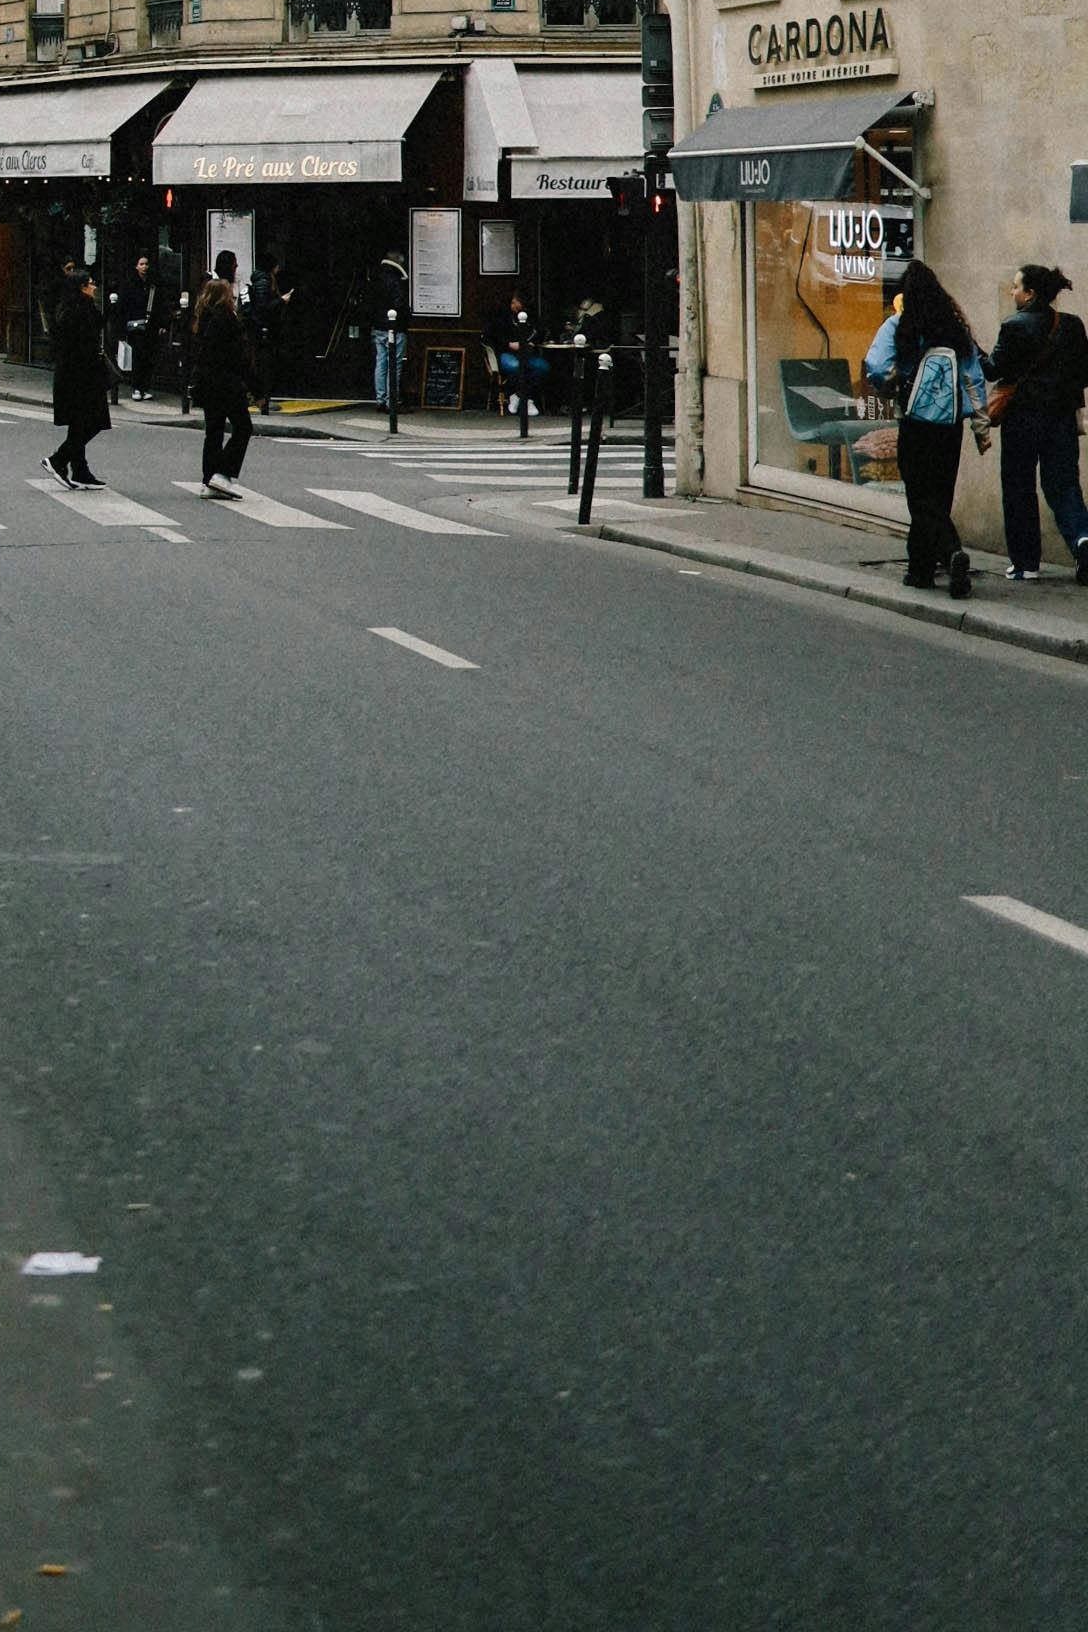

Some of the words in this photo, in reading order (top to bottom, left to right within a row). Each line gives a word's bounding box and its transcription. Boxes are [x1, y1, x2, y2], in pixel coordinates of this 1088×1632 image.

[748, 7, 890, 66] CARDONA
[762, 75, 787, 86] SIGNE
[791, 70, 817, 82] VOTRE
[822, 64, 870, 79] INTÉRIEUR
[193, 156, 218, 179] Le
[222, 155, 256, 178] Pré
[262, 161, 295, 177] aux
[301, 154, 359, 177] Clercs
[834, 254, 876, 276] LIVING
